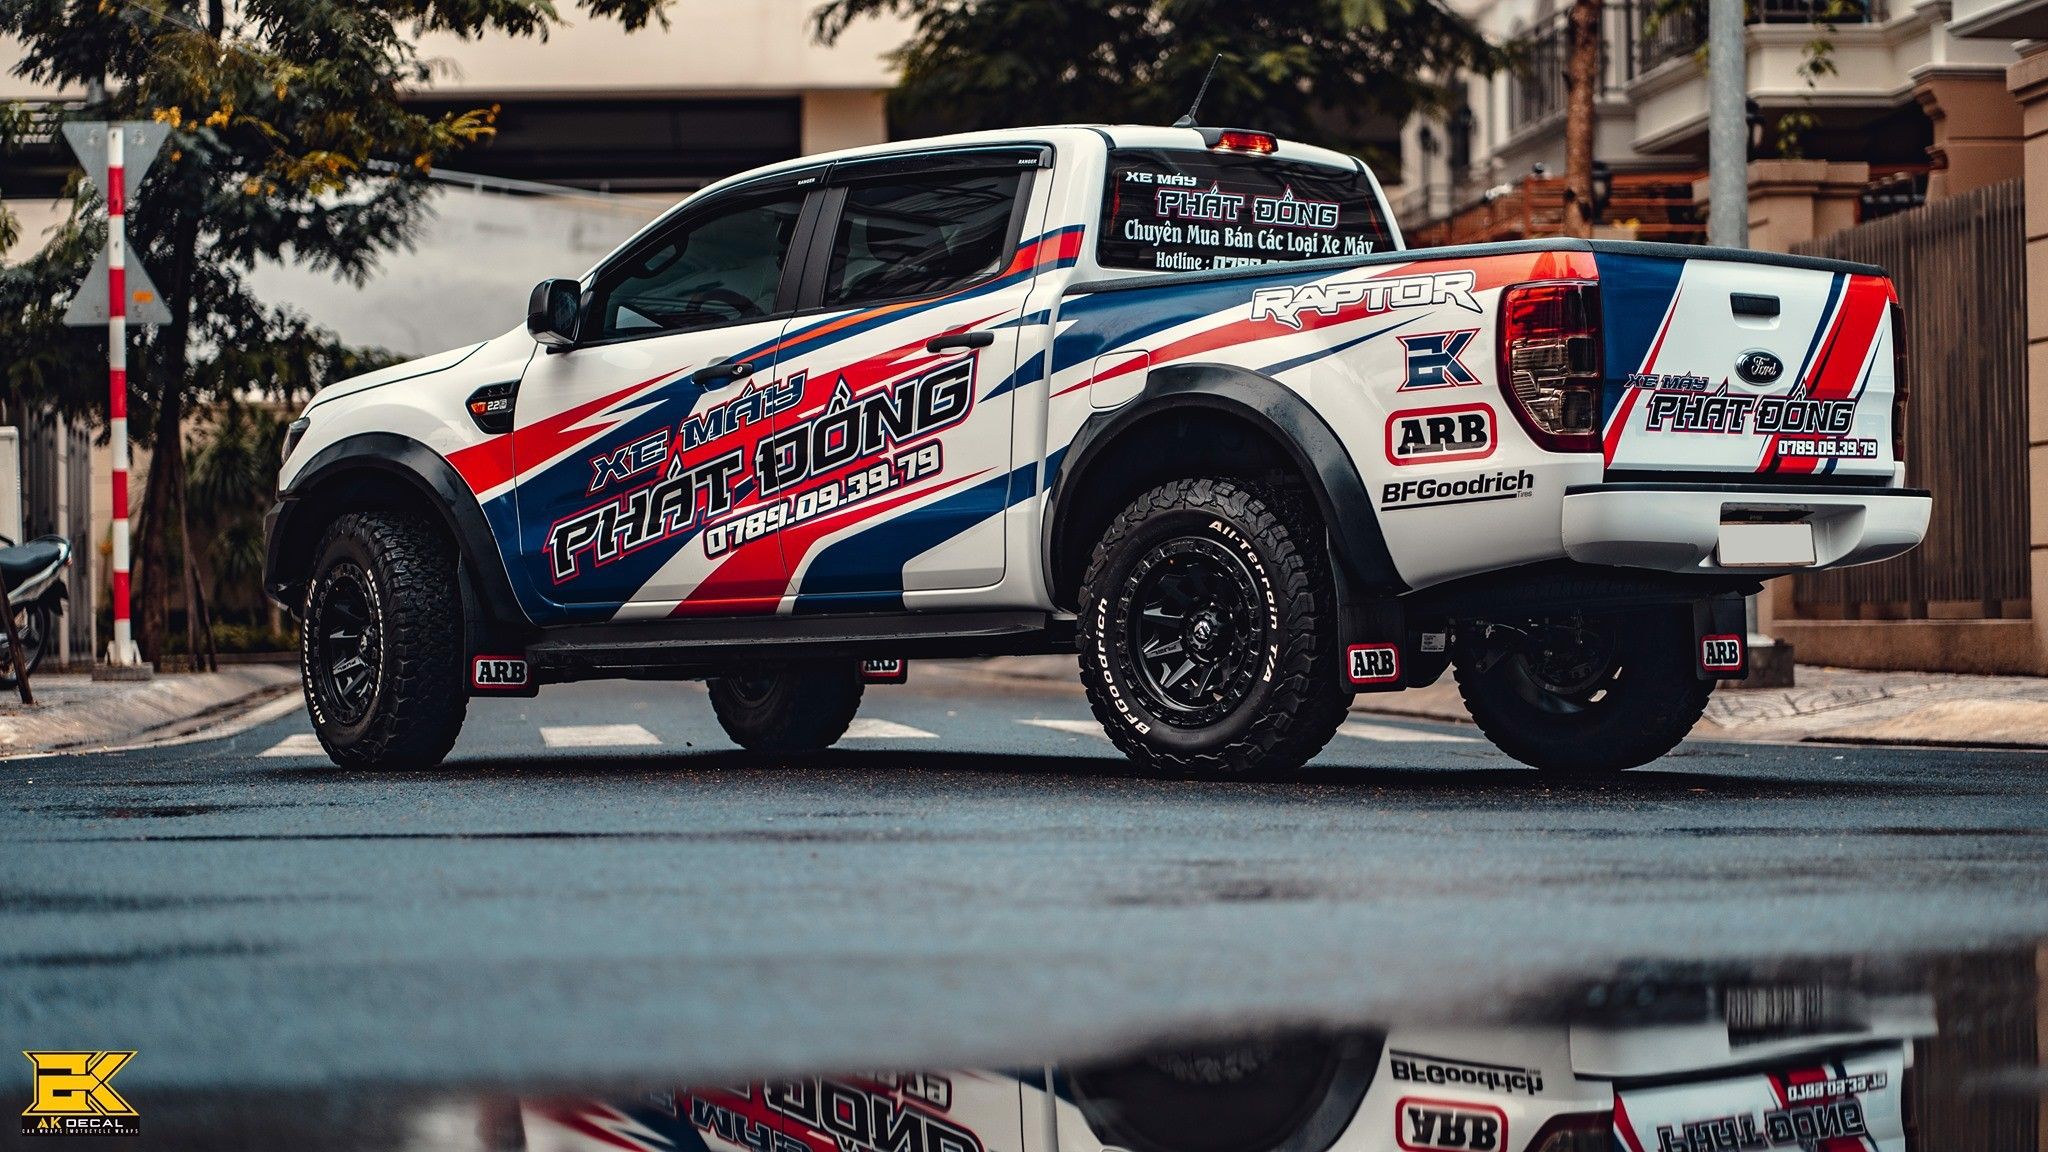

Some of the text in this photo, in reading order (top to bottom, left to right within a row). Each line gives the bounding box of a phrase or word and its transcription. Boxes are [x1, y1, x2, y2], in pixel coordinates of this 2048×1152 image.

[1125, 172, 1197, 187] XE MÁY
[1156, 183, 1243, 220] PHÁT
[1124, 219, 1182, 246] Chuyên
[1187, 224, 1220, 246] Mua
[1224, 225, 1253, 248] Bán
[1258, 226, 1284, 251] Các
[1287, 231, 1318, 257] Loại
[1321, 234, 1340, 254] Xe
[1156, 252, 1202, 270] Hotline
[1251, 271, 1483, 327] RAPTOR
[1626, 371, 1709, 391] XE MÁY
[1751, 356, 1777, 375] Ford
[1648, 385, 1753, 431] PHÁT
[592, 374, 806, 491] XE MÁY
[1398, 414, 1487, 455] ARB
[1778, 441, 1877, 456] 0789.09.39.79
[707, 444, 939, 554] 0789.09.39.79
[1382, 470, 1534, 503] BFGoodrich
[548, 450, 743, 578] PHÁT
[1209, 520, 1279, 683] All-Terrain T/A
[1097, 598, 1151, 735] BFGoodrich
[1353, 650, 1395, 677] ARB
[1705, 641, 1739, 665] ARB
[478, 661, 526, 683] ARB
